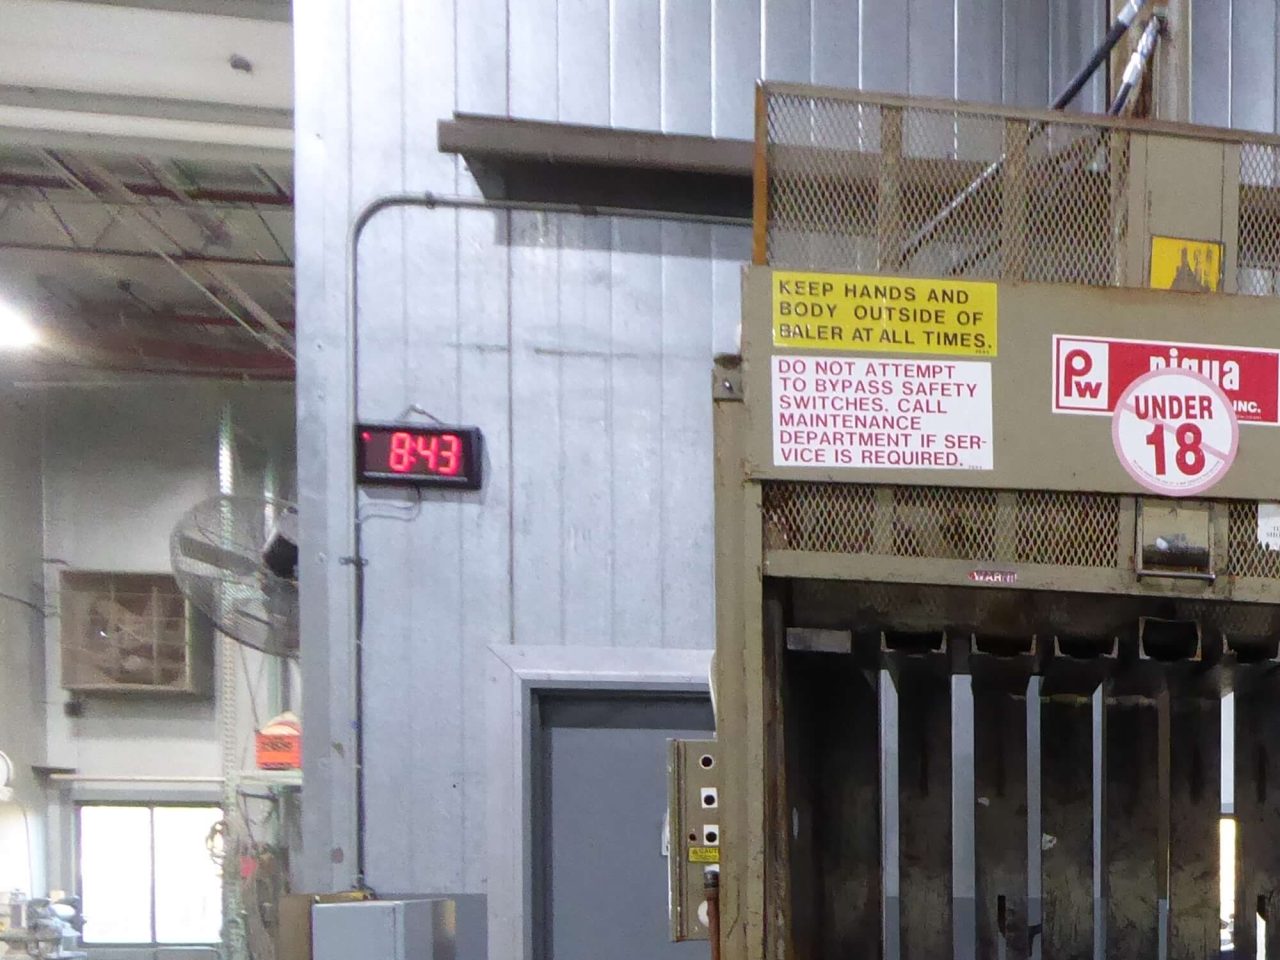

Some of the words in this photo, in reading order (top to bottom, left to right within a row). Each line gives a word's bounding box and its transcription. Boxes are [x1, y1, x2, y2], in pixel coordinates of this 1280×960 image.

[779, 280, 834, 297] KEEP
[844, 283, 916, 301] HANDS
[927, 288, 969, 304] AND
[779, 302, 837, 318] BODY
[854, 305, 946, 324] OUTSIDE
[957, 311, 984, 326] OF
[780, 324, 843, 341] BALER
[852, 328, 874, 343] AT
[879, 329, 915, 345] ALL
[922, 330, 992, 349] TIMES.
[778, 359, 806, 375] DO
[815, 360, 856, 376] NOT
[865, 362, 956, 379] ATTEMPT
[780, 377, 806, 392] TO
[815, 379, 893, 395] BYPASS
[902, 381, 978, 398] SAFETY
[779, 394, 889, 412] SWITCHES.
[897, 399, 948, 414] CALL
[1135, 395, 1213, 420] UNDER
[1233, 401, 1262, 414] INC.
[779, 413, 922, 431] MAINTENANCE
[780, 430, 912, 448] DEPARTMENT
[921, 434, 937, 449] IF
[944, 435, 987, 450] SER-
[1146, 422, 1206, 476] 18
[781, 448, 826, 463] VICE
[834, 449, 852, 464] IS
[861, 450, 963, 467] REQUIRED.
